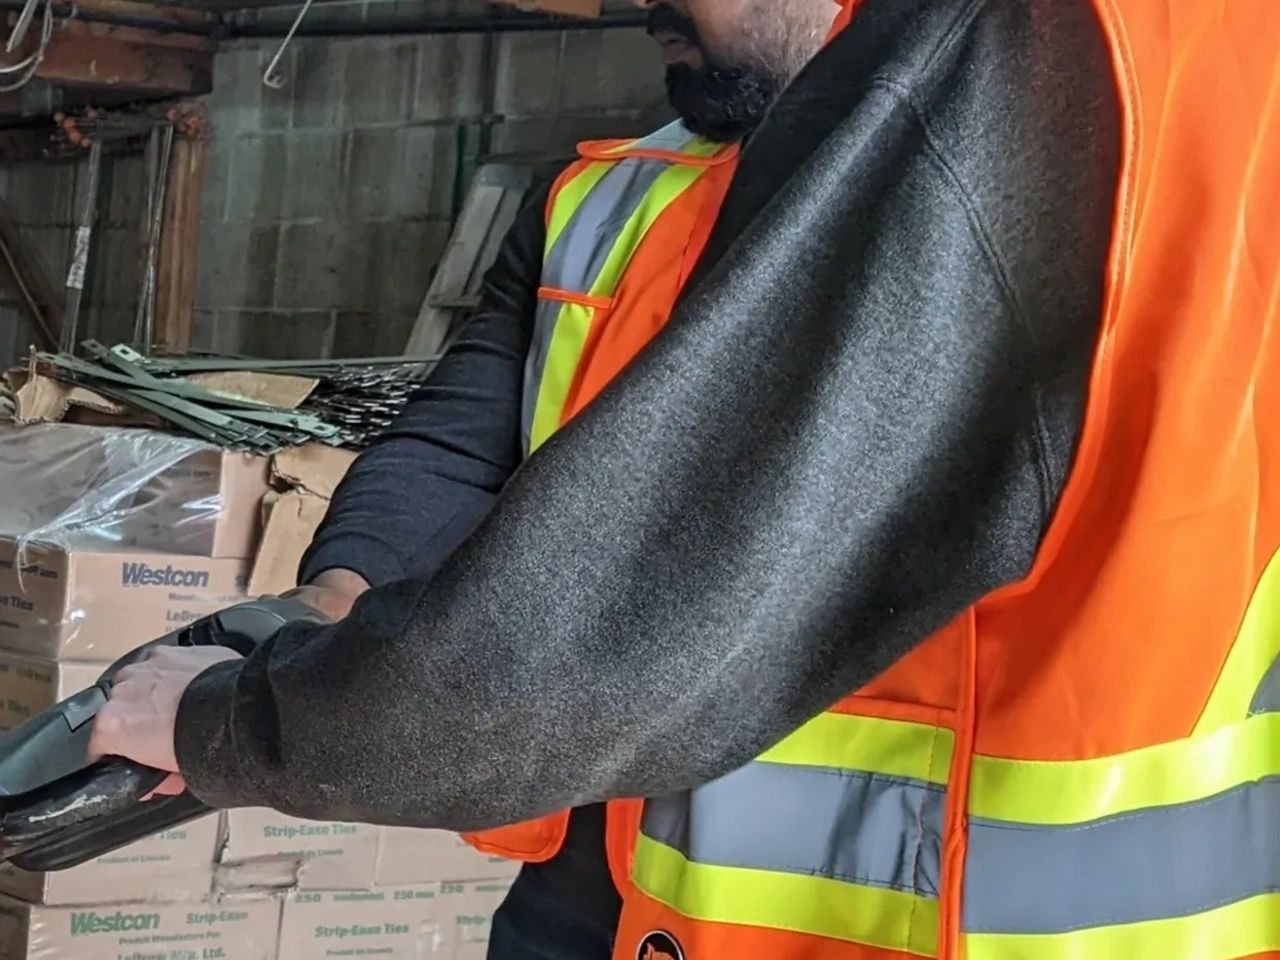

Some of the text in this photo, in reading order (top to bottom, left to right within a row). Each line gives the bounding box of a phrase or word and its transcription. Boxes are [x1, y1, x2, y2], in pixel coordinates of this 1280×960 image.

[122, 562, 210, 588] Westcon
[263, 824, 357, 839] Strip-Ease Ties
[393, 890, 414, 900] 250
[70, 911, 249, 936] Westcon Strip-Ease
[315, 923, 409, 939] Strip-Ease Ties
[202, 947, 225, 960] Ltd.
